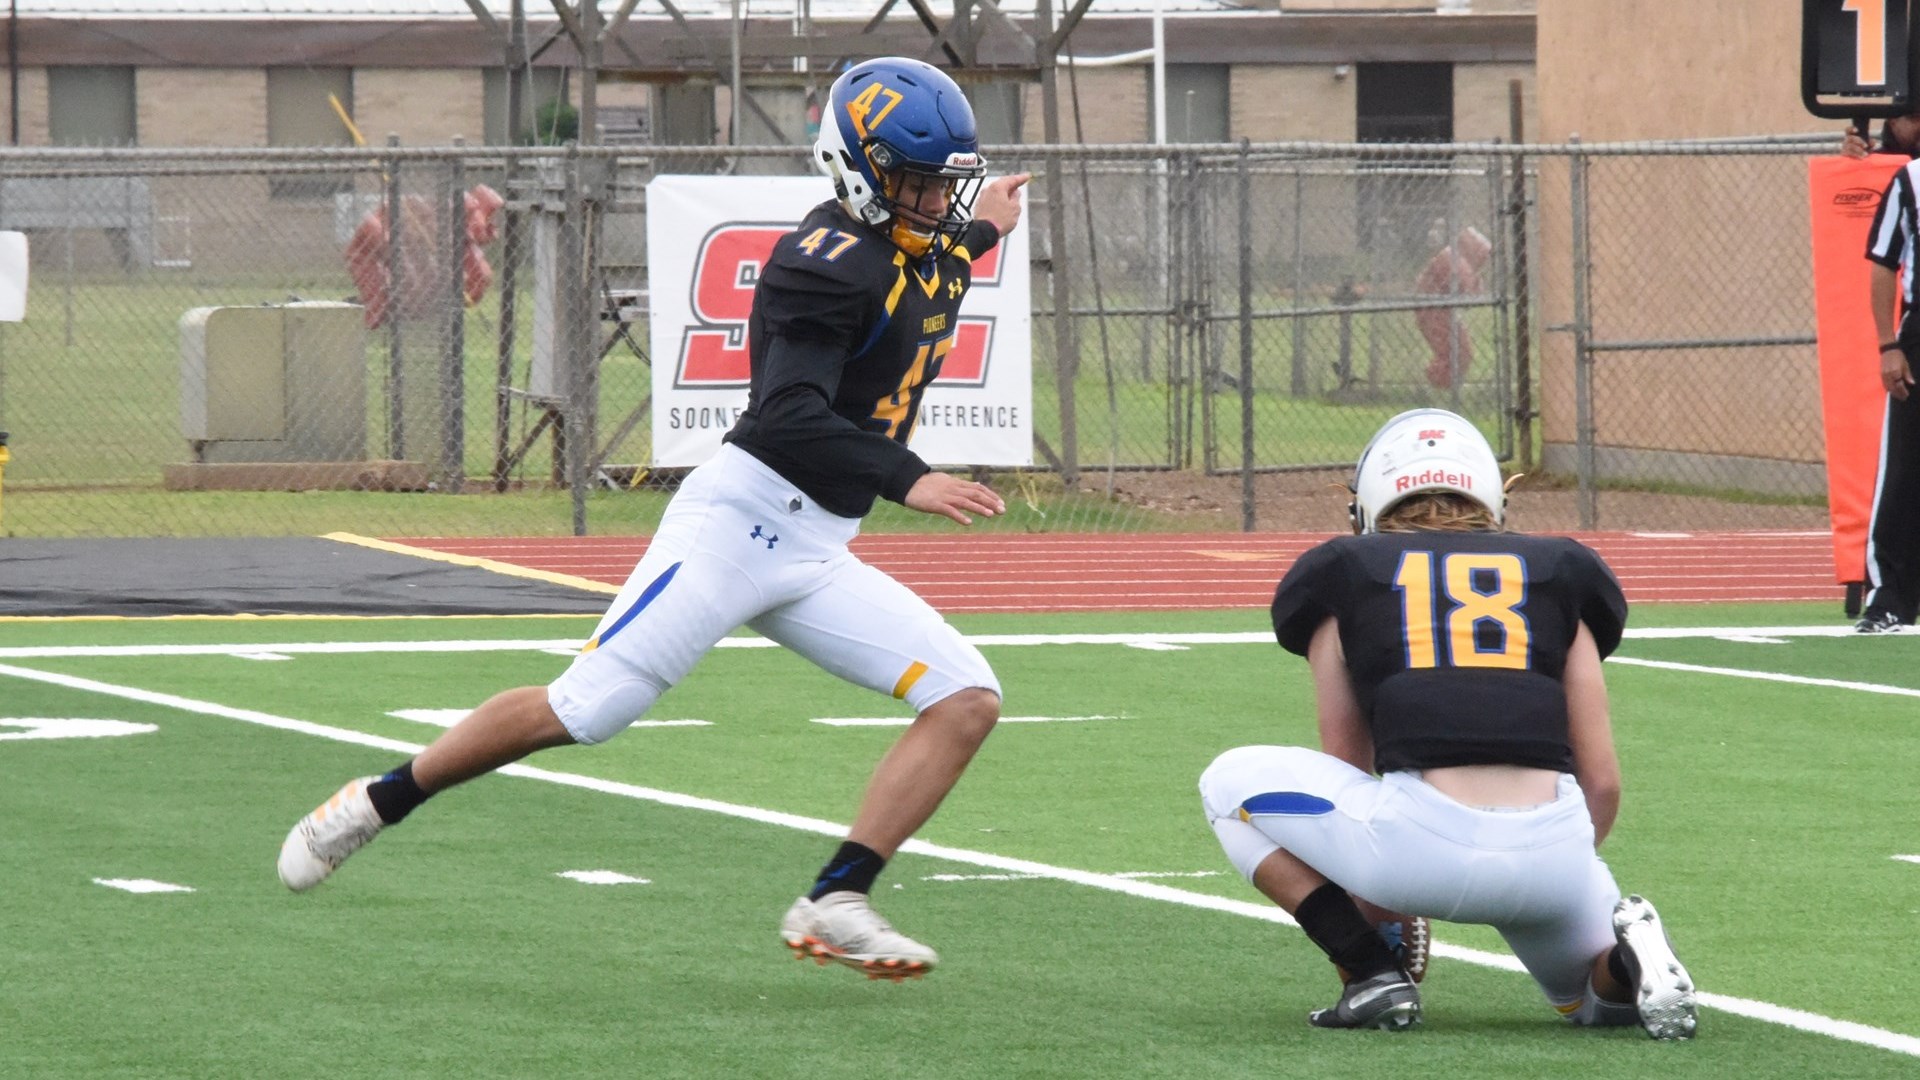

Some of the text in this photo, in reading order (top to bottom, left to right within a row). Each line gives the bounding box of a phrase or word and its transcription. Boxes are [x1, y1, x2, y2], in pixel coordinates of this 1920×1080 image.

[1841, 0, 1886, 86] 1
[850, 82, 904, 131] 47
[952, 157, 977, 166] Riddell
[796, 227, 862, 262] 47
[922, 313, 946, 335] PIONEERS
[868, 337, 955, 441] 47
[918, 405, 1018, 428] NFERENCE
[1395, 469, 1472, 493] Riddell
[1391, 550, 1533, 670] 18
